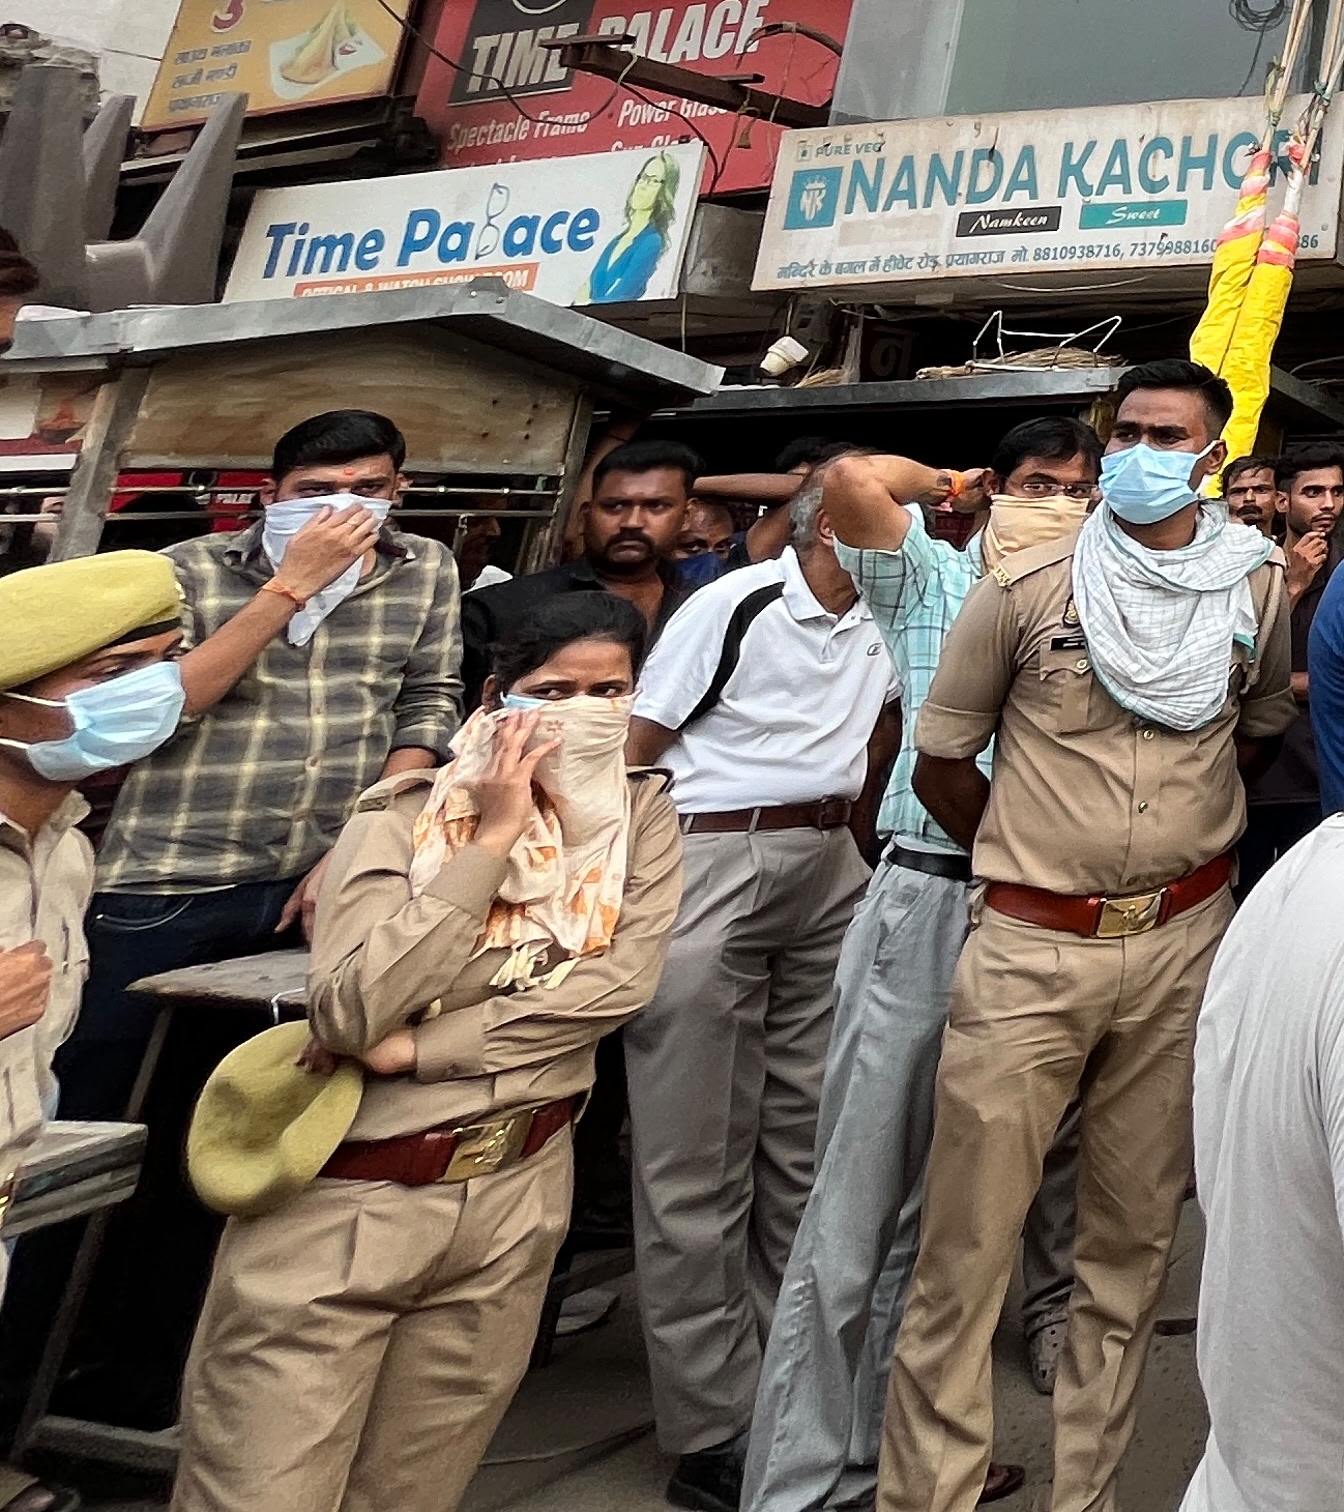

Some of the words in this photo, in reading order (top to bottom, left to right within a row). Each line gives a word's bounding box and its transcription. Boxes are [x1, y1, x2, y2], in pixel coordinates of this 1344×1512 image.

[466, 22, 580, 94] TIME
[447, 115, 531, 151] Spectacle
[618, 98, 678, 128] Power
[815, 143, 851, 159] PURE
[854, 141, 882, 155] VEG
[844, 144, 1040, 216] NANDA
[969, 213, 1048, 234] Namkeen
[1105, 206, 1162, 225] Sweet
[263, 221, 386, 280] Time
